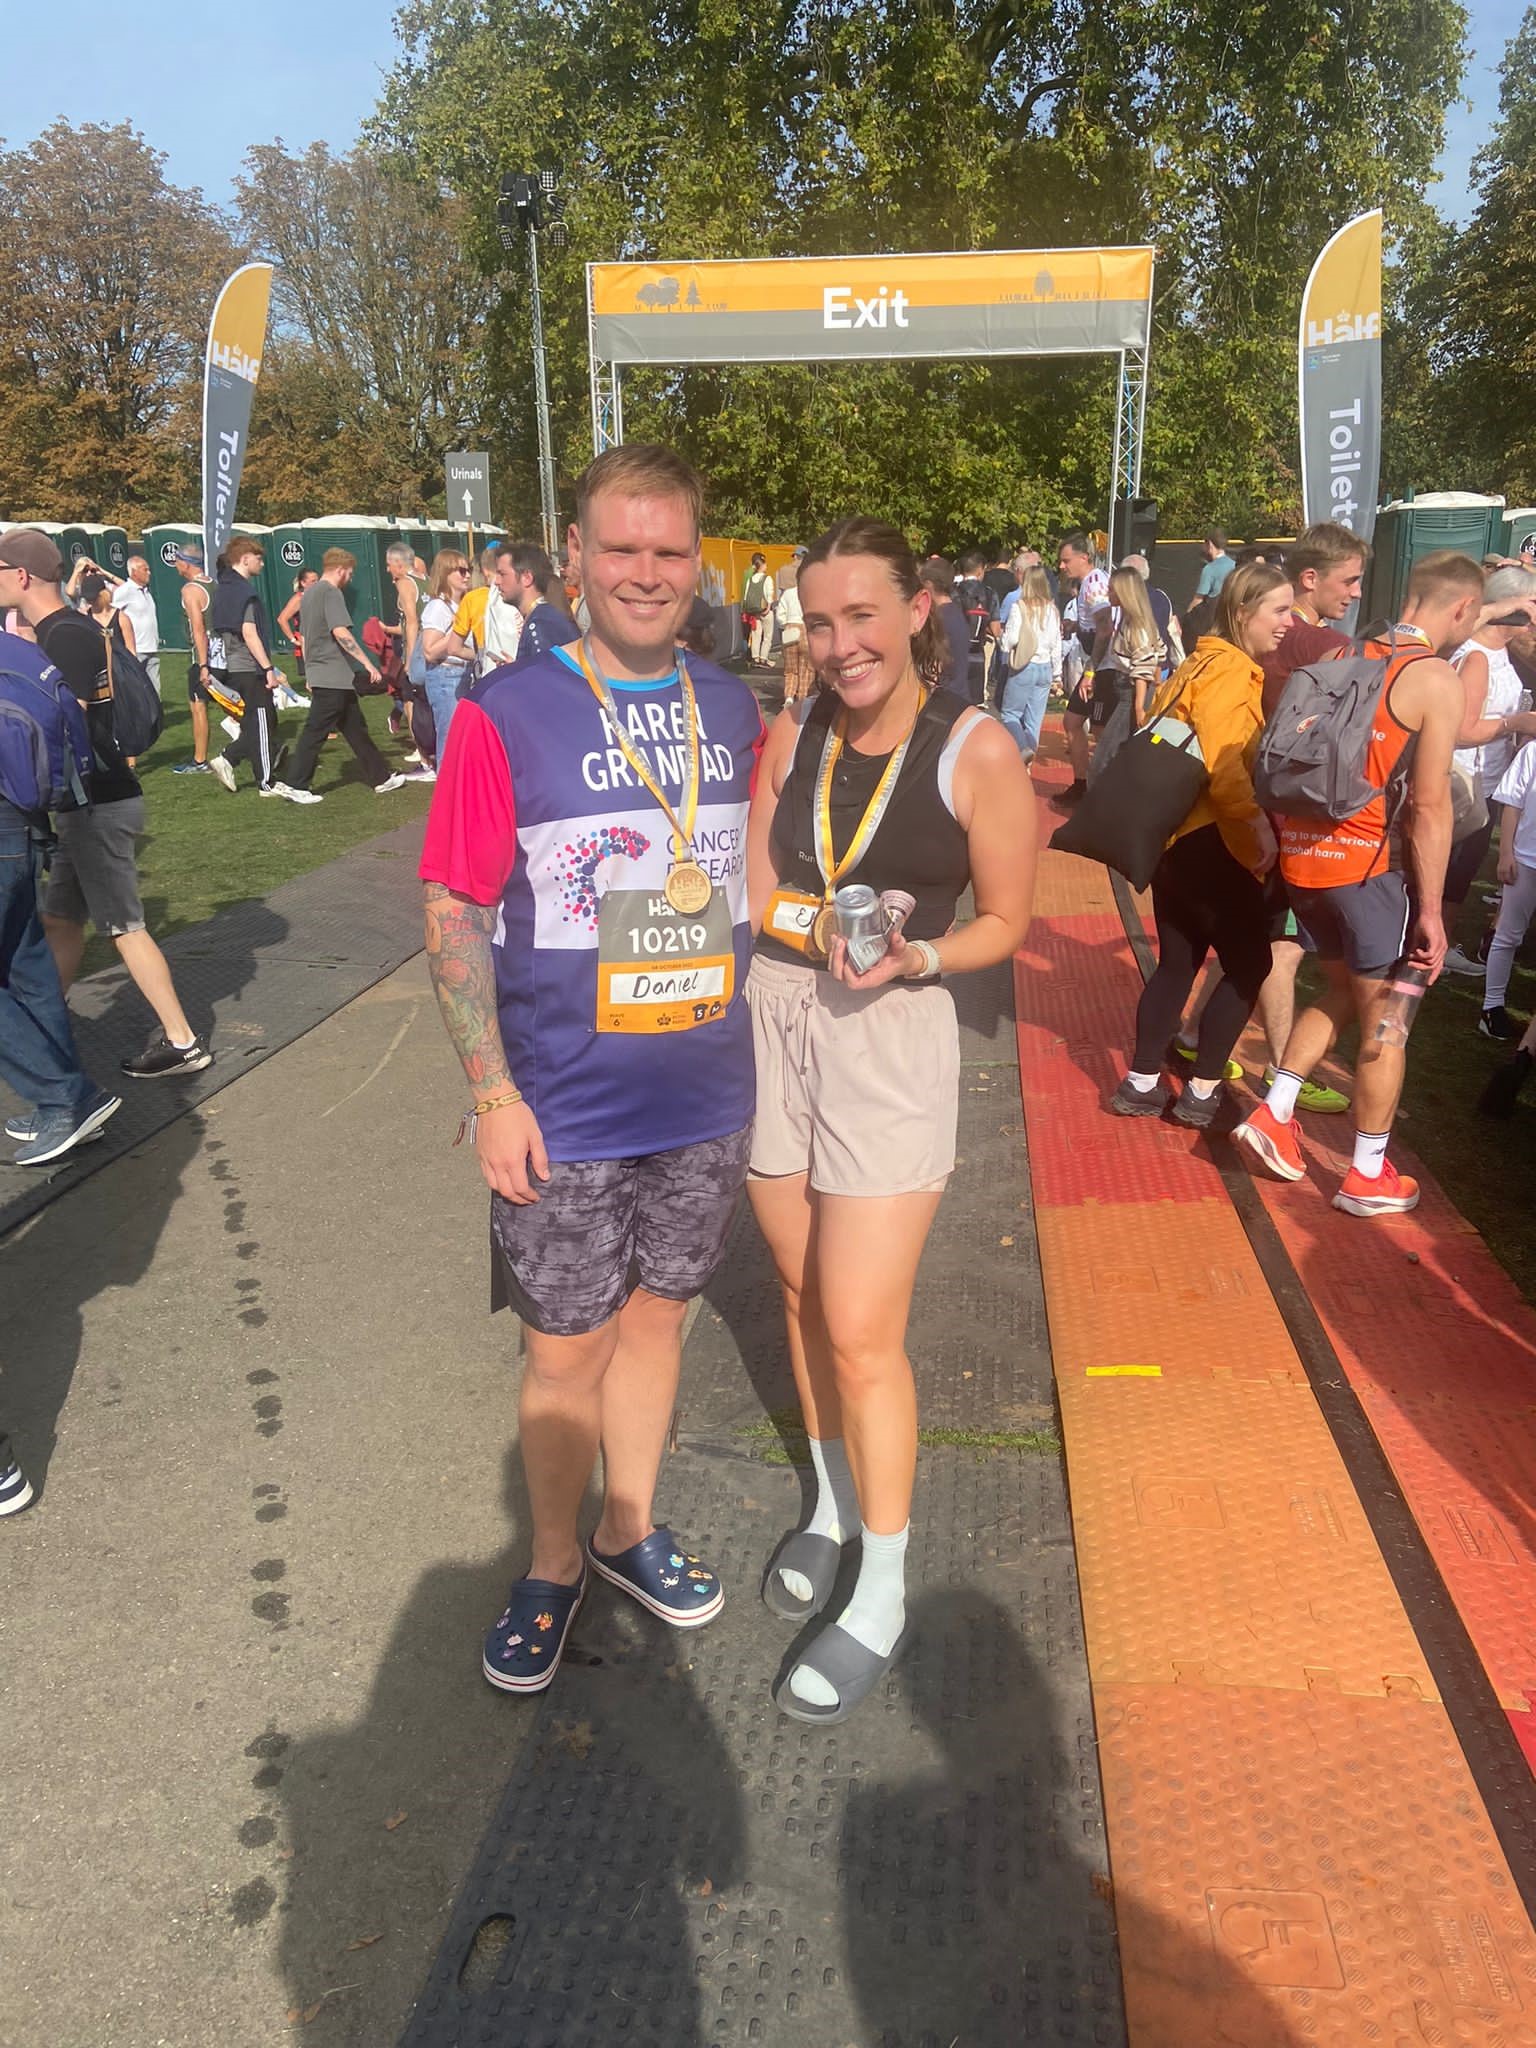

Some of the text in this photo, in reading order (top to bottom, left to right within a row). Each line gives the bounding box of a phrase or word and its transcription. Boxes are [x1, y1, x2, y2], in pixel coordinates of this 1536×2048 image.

[823, 286, 909, 329] Exit
[1308, 312, 1380, 346] Half
[212, 340, 261, 384] Half
[451, 466, 482, 481] Urinals
[1314, 846, 1346, 860] harm
[628, 924, 708, 955] 10219
[632, 971, 699, 999] Daniel
